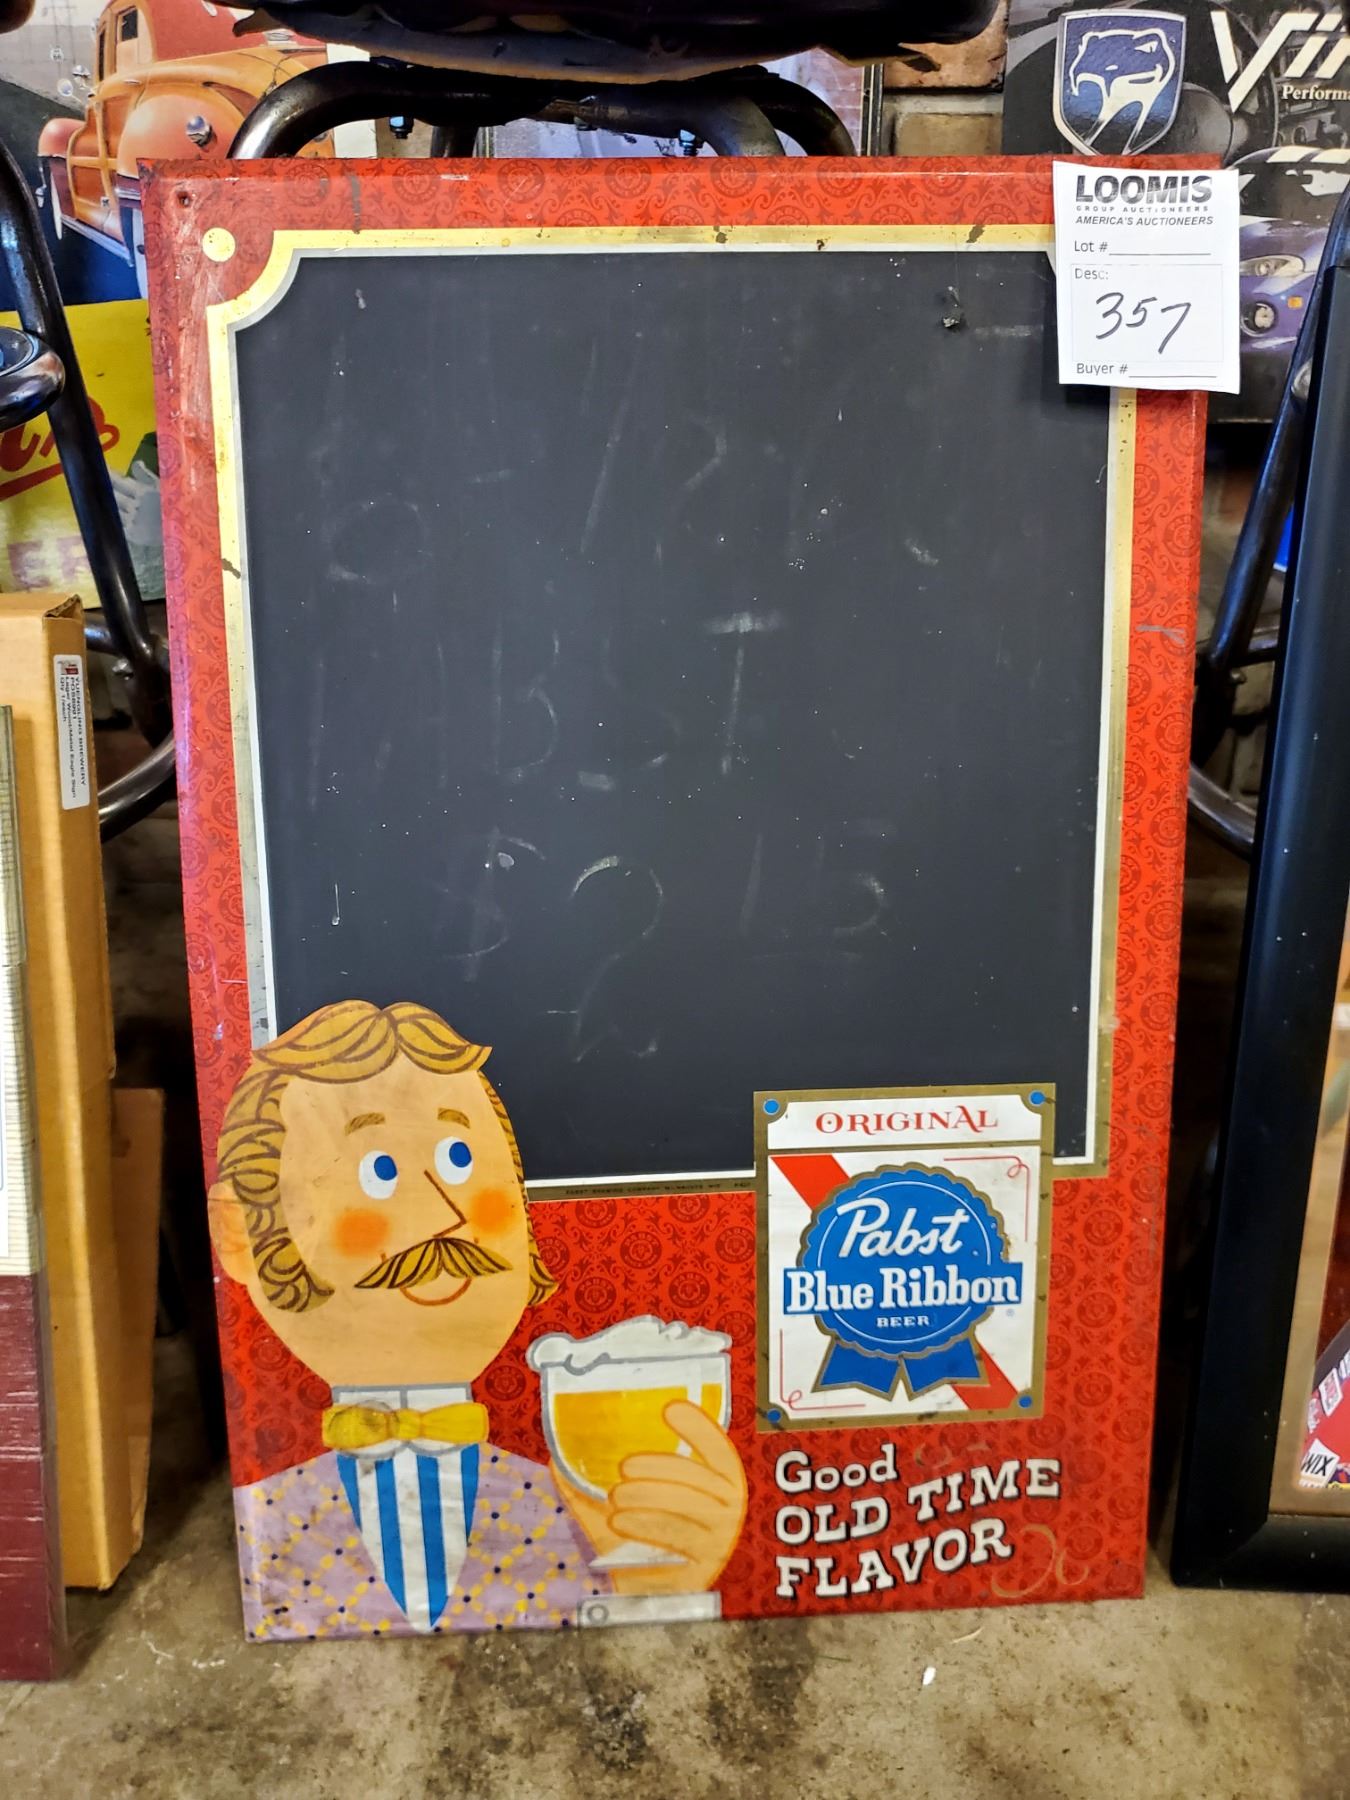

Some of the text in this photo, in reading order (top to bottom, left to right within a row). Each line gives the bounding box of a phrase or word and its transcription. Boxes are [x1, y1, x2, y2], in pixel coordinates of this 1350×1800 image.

[1281, 84, 1350, 101] Perform
[1075, 175, 1213, 204] LOOMIS
[1075, 216, 1214, 226] AMERICA'S AUCTIONEERS
[1074, 240, 1095, 253] Lot
[1074, 268, 1109, 280] Desc:
[1095, 292, 1192, 355] 357
[1076, 363, 1115, 376] Buyer
[815, 1105, 998, 1136] ORIGINAL
[836, 1197, 970, 1258] Pabst
[786, 1265, 1019, 1313] Blue Ribbon
[876, 1314, 930, 1328] BEER
[774, 1443, 898, 1493] Good
[774, 1458, 1062, 1545] OLD TIME
[774, 1517, 1013, 1598] FLAVOR
